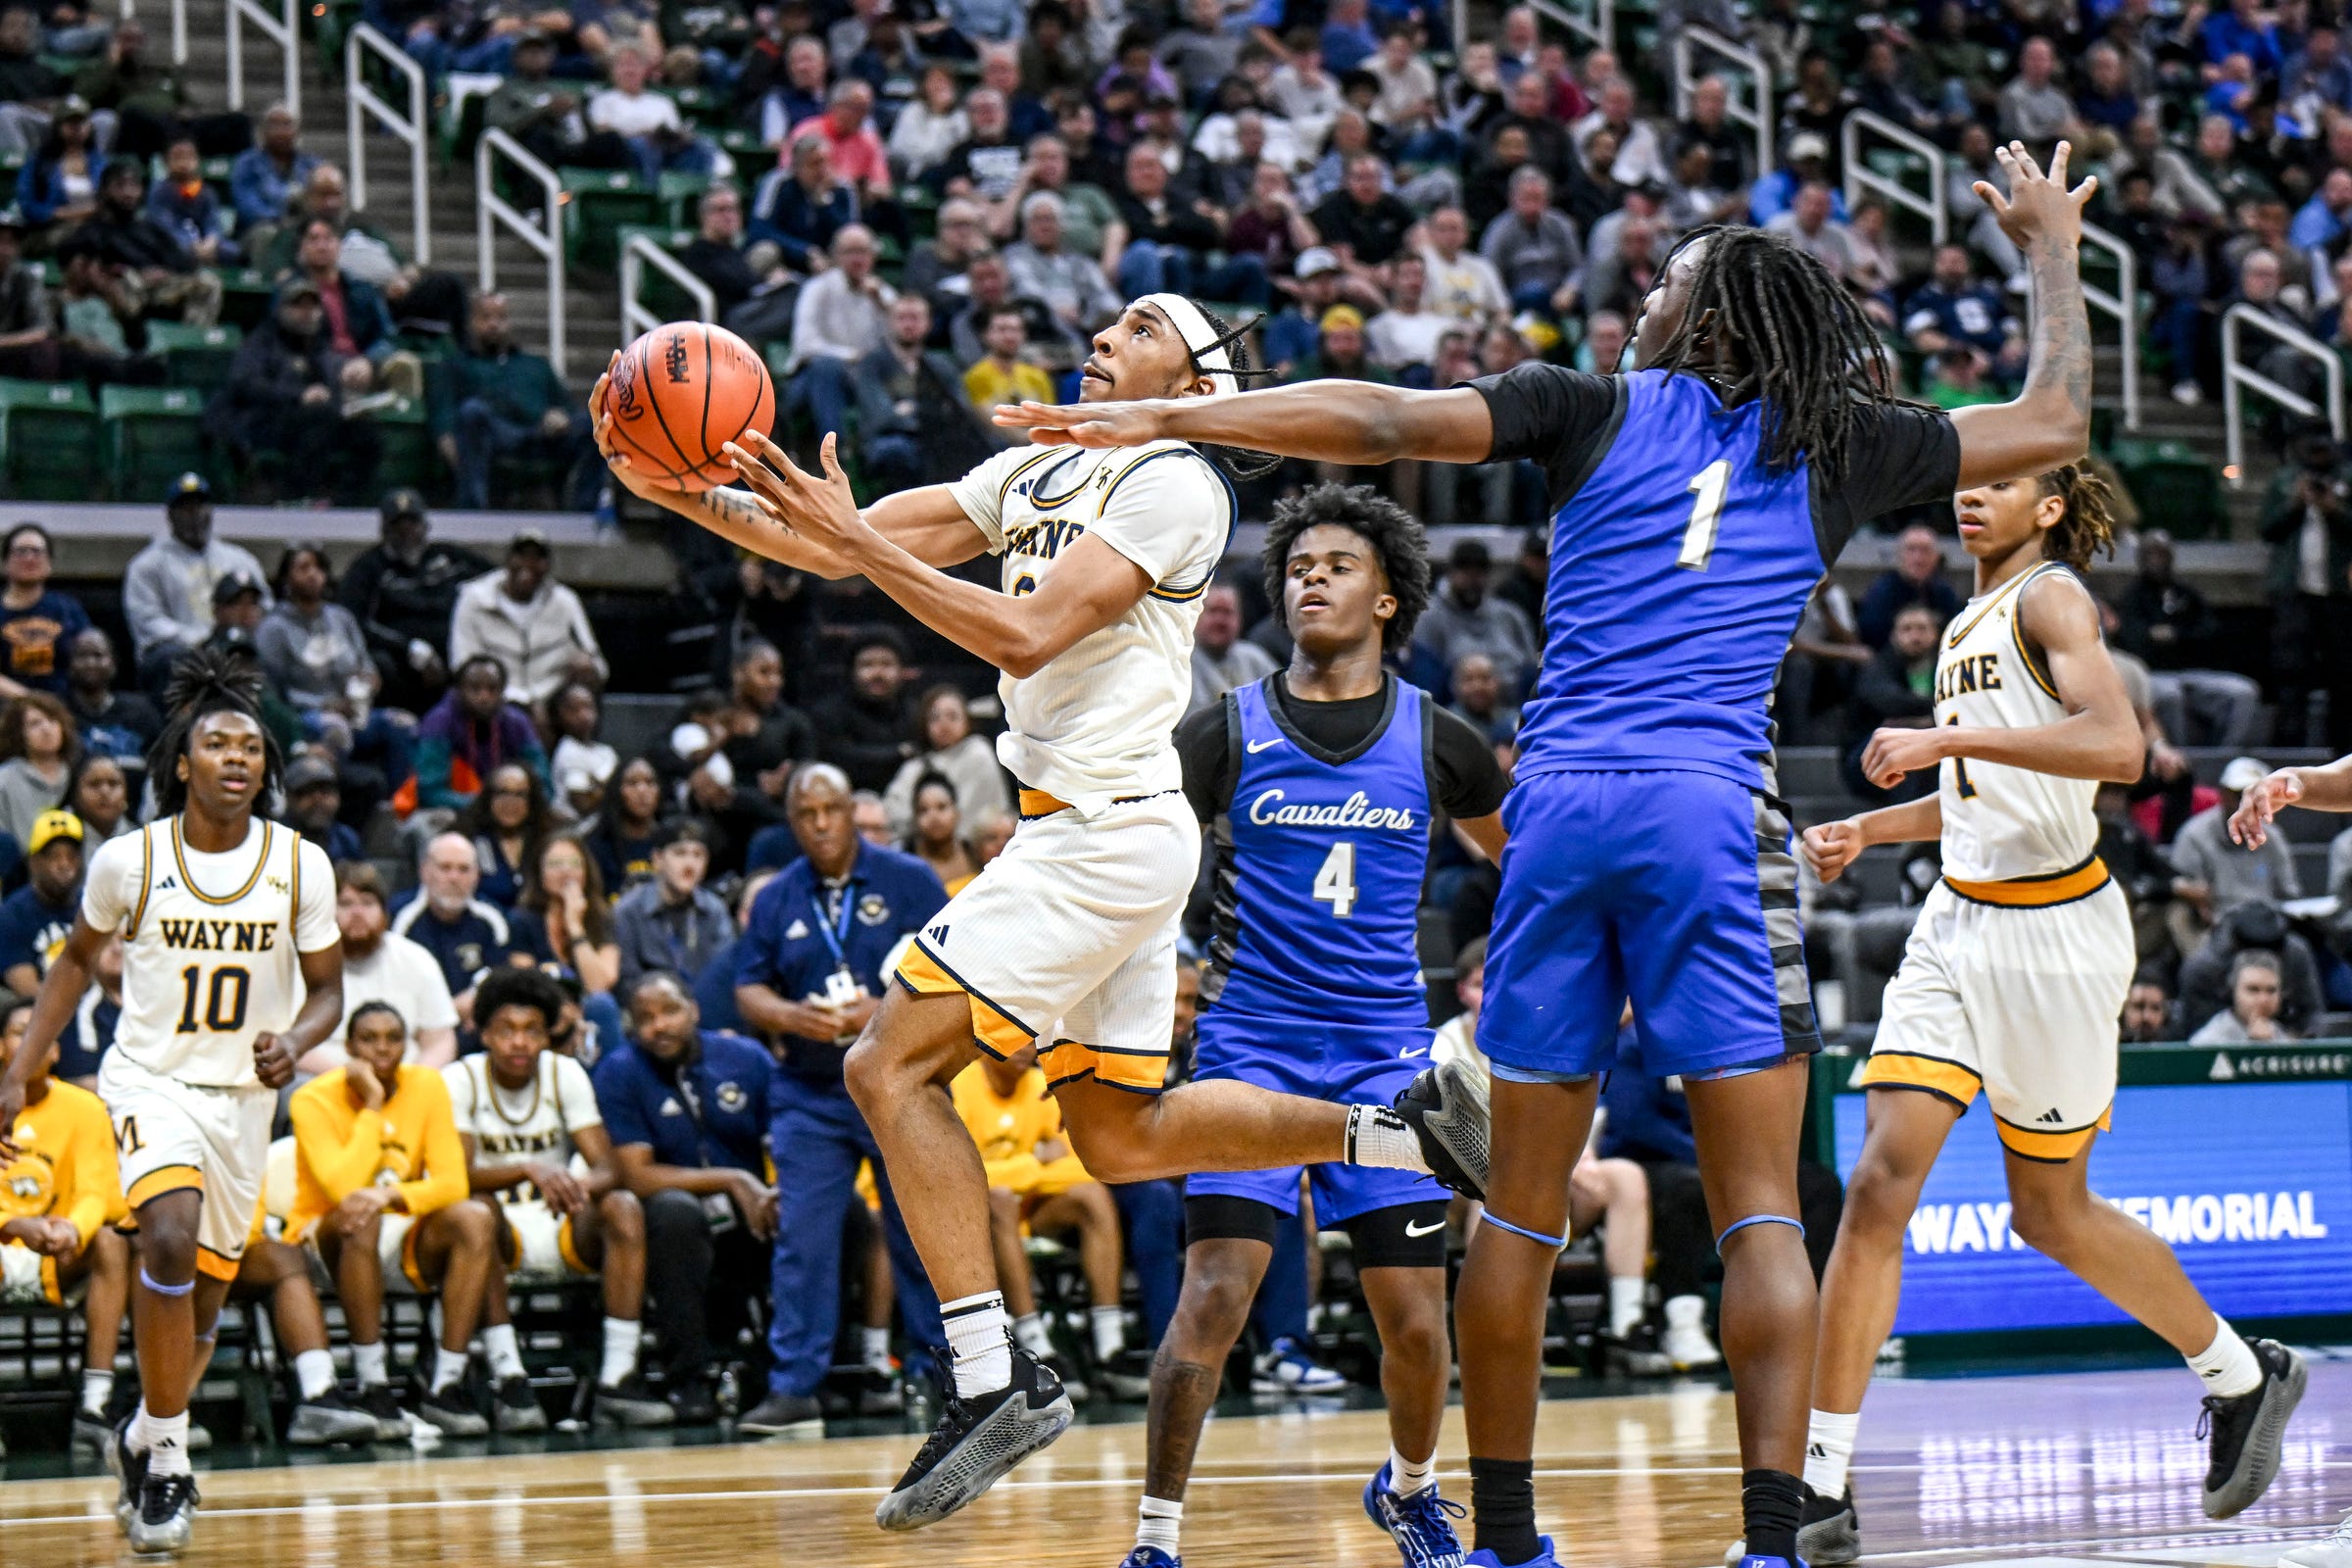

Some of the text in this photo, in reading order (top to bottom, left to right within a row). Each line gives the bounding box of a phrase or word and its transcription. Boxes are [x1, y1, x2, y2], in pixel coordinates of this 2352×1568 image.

[1675, 459, 1733, 573] 1
[1935, 653, 2002, 708] AYNE
[1250, 788, 1414, 830] Cavaliers
[1312, 841, 1358, 918] 4
[160, 917, 278, 954] WAYNE
[174, 961, 251, 1036] 10
[1907, 1191, 2328, 1254] WAY EMORIAL
